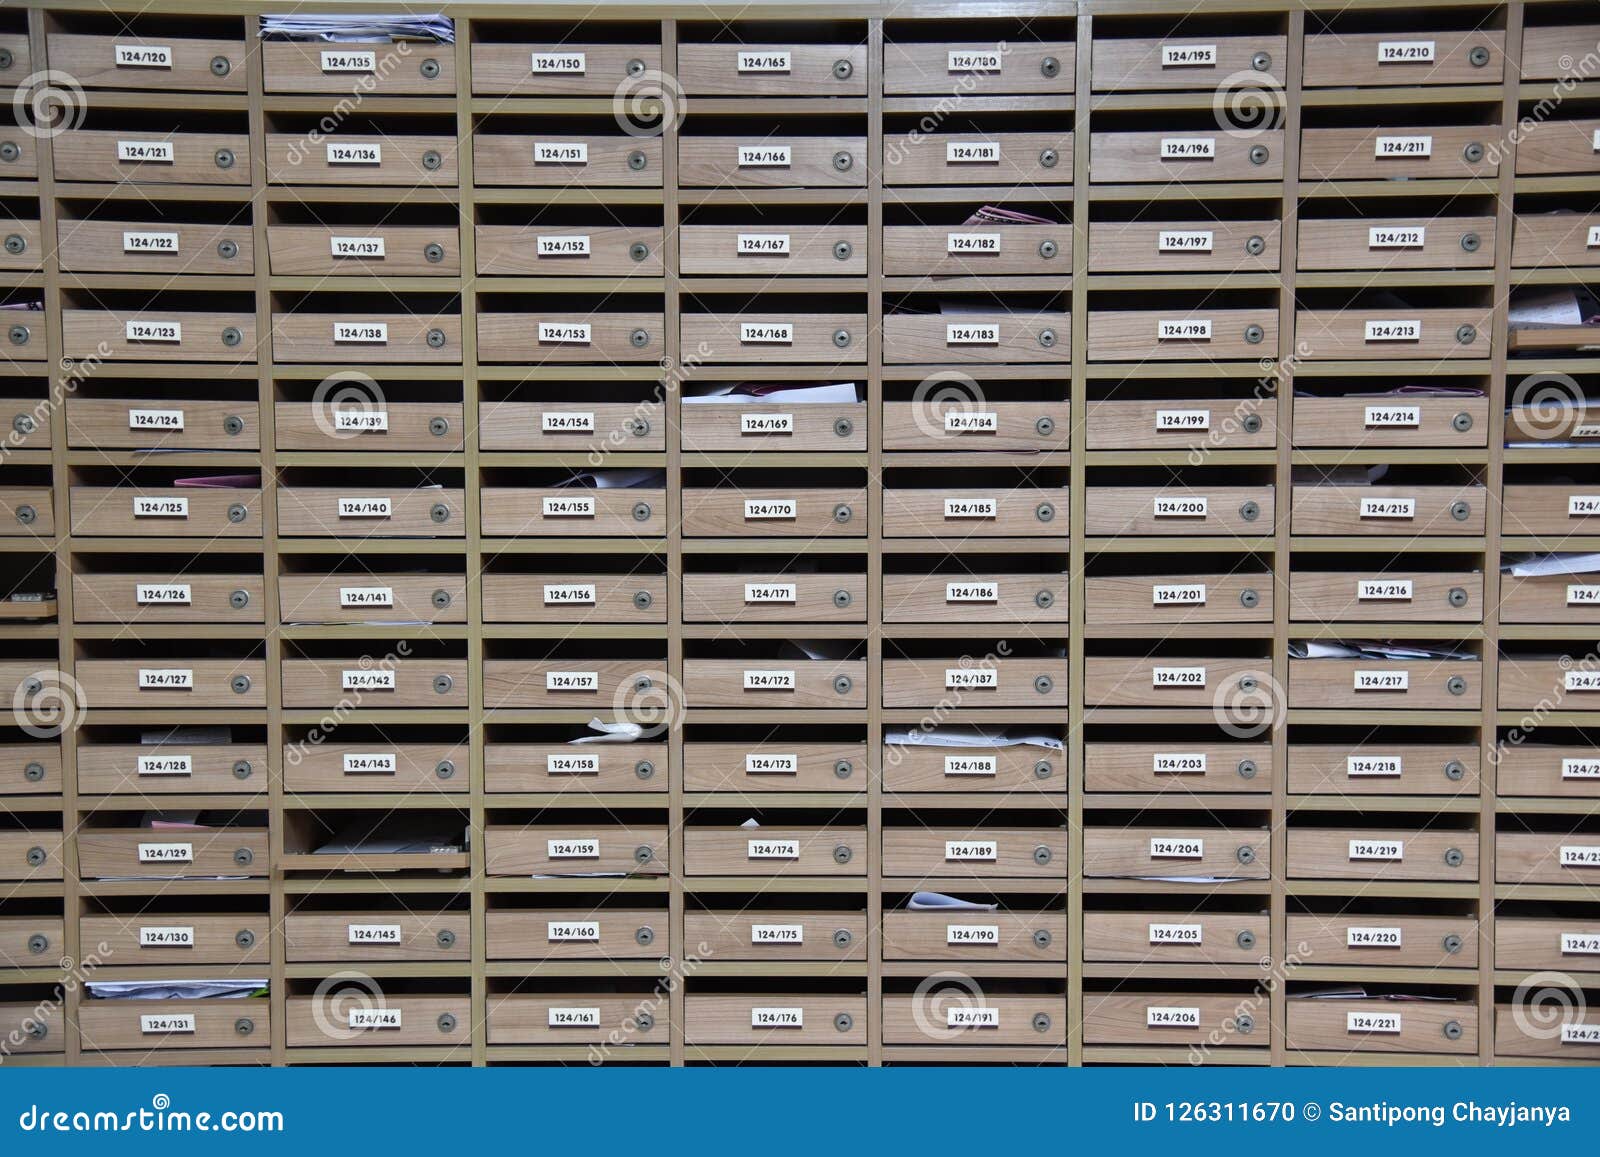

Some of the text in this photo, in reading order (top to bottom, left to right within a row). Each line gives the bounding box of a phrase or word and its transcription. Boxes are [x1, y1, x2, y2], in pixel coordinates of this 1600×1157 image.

[121, 51, 167, 63] 124/120
[1168, 50, 1211, 62] 124/195
[1384, 47, 1430, 58] 124/210
[327, 57, 371, 68] 124/135
[536, 58, 581, 69] 124/150
[743, 57, 786, 68] 124/165
[953, 56, 997, 67] 124/180
[125, 146, 167, 158] 124/121
[953, 148, 994, 158] 124/181
[1167, 143, 1209, 154] 124/196
[1383, 142, 1425, 153] 124/211
[332, 149, 376, 160] 124/136
[540, 148, 581, 159] 124/151
[743, 152, 786, 162] 124/166
[129, 237, 173, 248] 124/122
[1165, 236, 1207, 247] 124/197
[1375, 232, 1419, 243] 124/212
[337, 242, 379, 253] 124/137
[542, 241, 585, 252] 124/152
[743, 239, 785, 250] 124/167
[953, 238, 995, 249] 124/182
[132, 326, 176, 338] 124/123
[339, 328, 382, 339] 124/138
[544, 328, 586, 339] 124/153
[745, 328, 788, 339] 124/168
[952, 329, 994, 340] 124/183
[1164, 325, 1207, 336] 124/198
[1372, 326, 1415, 337] 124/213
[135, 415, 179, 426] 124/124
[341, 417, 382, 427] 124/139
[547, 417, 590, 427] 124/154
[950, 417, 993, 428] 124/184
[1162, 415, 1205, 426] 124/199
[1371, 412, 1414, 422] 124/214
[746, 419, 788, 429] 124/169
[140, 502, 183, 513] 124/125
[343, 503, 387, 513] 124/140
[548, 502, 589, 512] 124/155
[749, 505, 792, 515] 124/170
[949, 504, 992, 514] 124/185
[1157, 503, 1204, 513] 124/200
[1367, 503, 1409, 514] 124/215
[143, 590, 186, 600] 124/126
[549, 590, 590, 600] 124/156
[751, 588, 790, 599] 124/171
[951, 588, 993, 598] 124/186
[1158, 590, 1201, 600] 124/201
[1365, 585, 1407, 596] 124/216
[346, 593, 387, 602] 124/141
[145, 674, 187, 685] 124/127
[347, 675, 390, 686] 124/142
[552, 677, 593, 687] 124/157
[749, 675, 790, 686] 124/172
[951, 674, 992, 684] 124/187
[1157, 672, 1202, 682] 124/202
[1360, 676, 1403, 686] 124/217
[144, 760, 187, 771] 124/128
[348, 759, 391, 769] 124/143
[553, 759, 594, 769] 124/158
[752, 759, 792, 769] 124/173
[950, 761, 992, 771] 124/188
[1158, 759, 1202, 769] 124/203
[1353, 762, 1396, 772] 124/218
[1567, 764, 1600, 774] 124/2
[144, 848, 187, 858] 124/129
[553, 845, 594, 854] 124/159
[753, 845, 794, 855] 124/174
[951, 846, 992, 856] 124/189
[1154, 843, 1200, 854] 124/204
[1355, 845, 1398, 856] 124/219
[1565, 851, 1600, 862] 124/2
[145, 932, 189, 942] 124/130
[354, 930, 396, 939] 124/145
[553, 927, 595, 937] 124/160
[757, 930, 797, 939] 124/175
[952, 930, 994, 940] 124/190
[1154, 929, 1198, 939] 124/205
[1351, 932, 1398, 943] 124/220
[1567, 939, 1600, 950] 124/2
[355, 1014, 397, 1024] 124/146
[555, 1013, 594, 1023] 124/161
[758, 1013, 798, 1023] 124/176
[954, 1013, 993, 1022] 124/191
[1152, 1012, 1196, 1023] 124/206
[148, 1019, 189, 1029] 124/131
[1354, 1018, 1395, 1029] 124/221
[1567, 1029, 1600, 1040] 124/2
